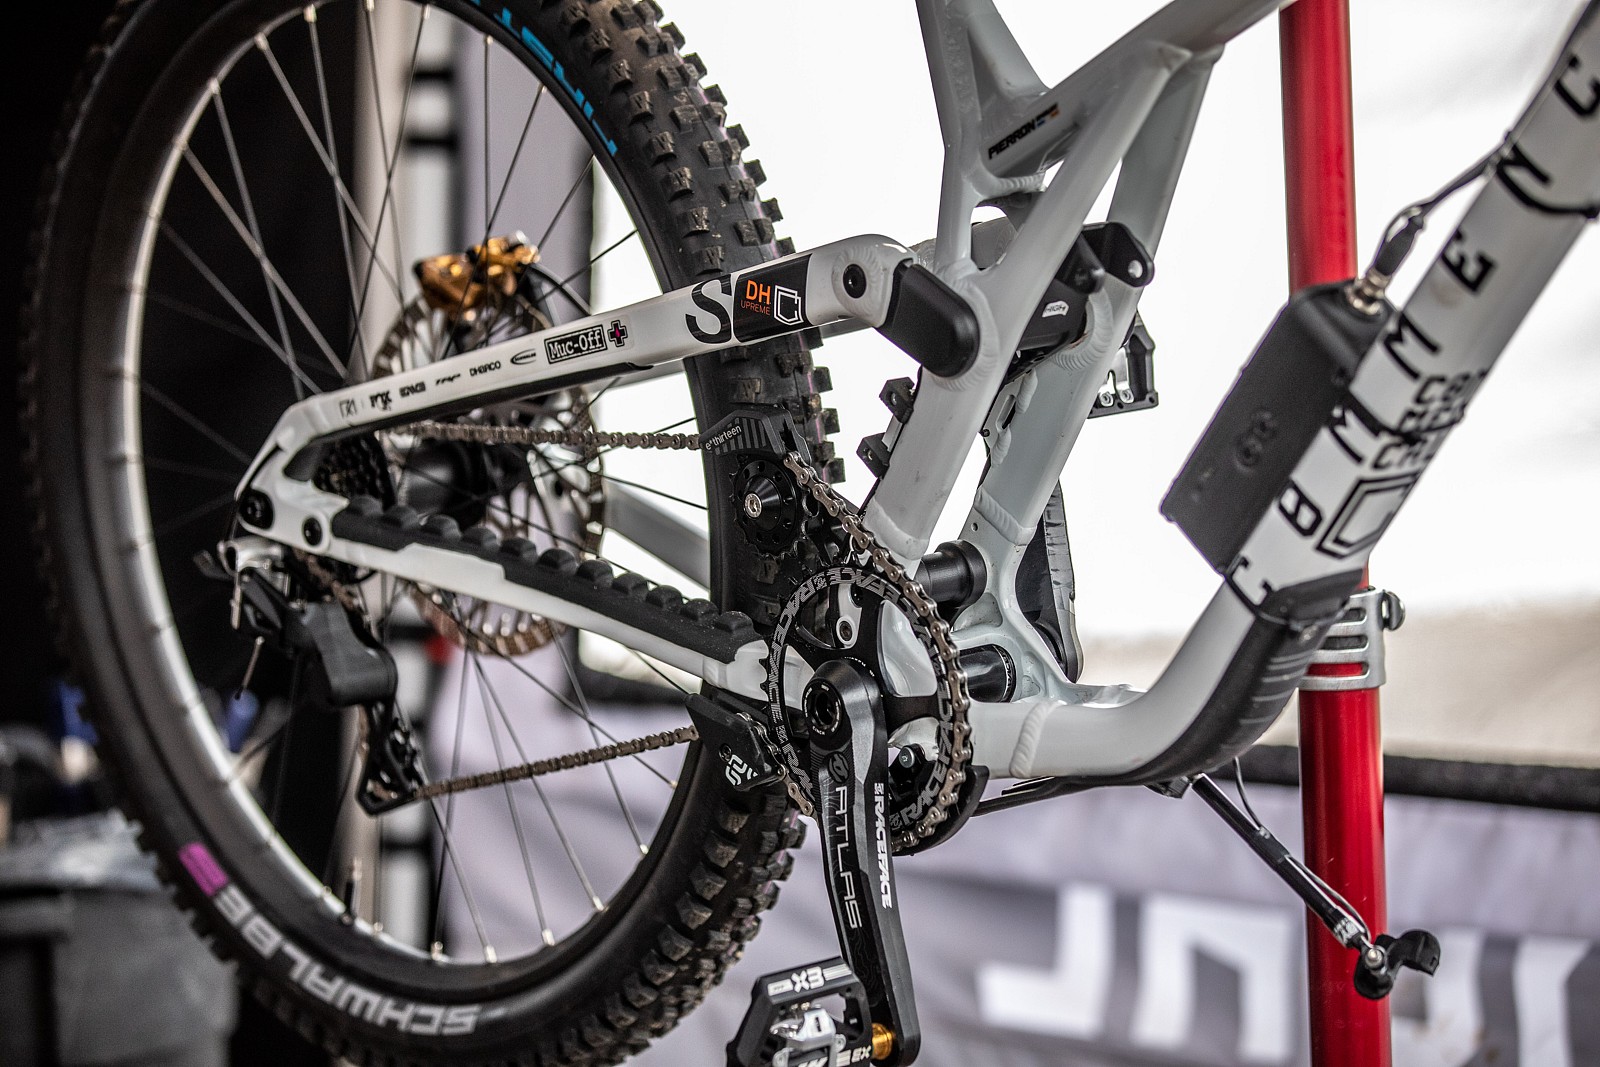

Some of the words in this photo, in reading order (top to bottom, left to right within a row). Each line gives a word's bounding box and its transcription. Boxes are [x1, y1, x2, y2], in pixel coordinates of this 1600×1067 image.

[988, 119, 1036, 160] PIERRON
[741, 299, 771, 316] UPREME
[746, 280, 771, 305] DH
[549, 328, 603, 359] Muc-Off
[835, 785, 863, 930] ATLAS
[874, 796, 893, 910] RACEFACE
[213, 884, 482, 1036] SCHWALBE
